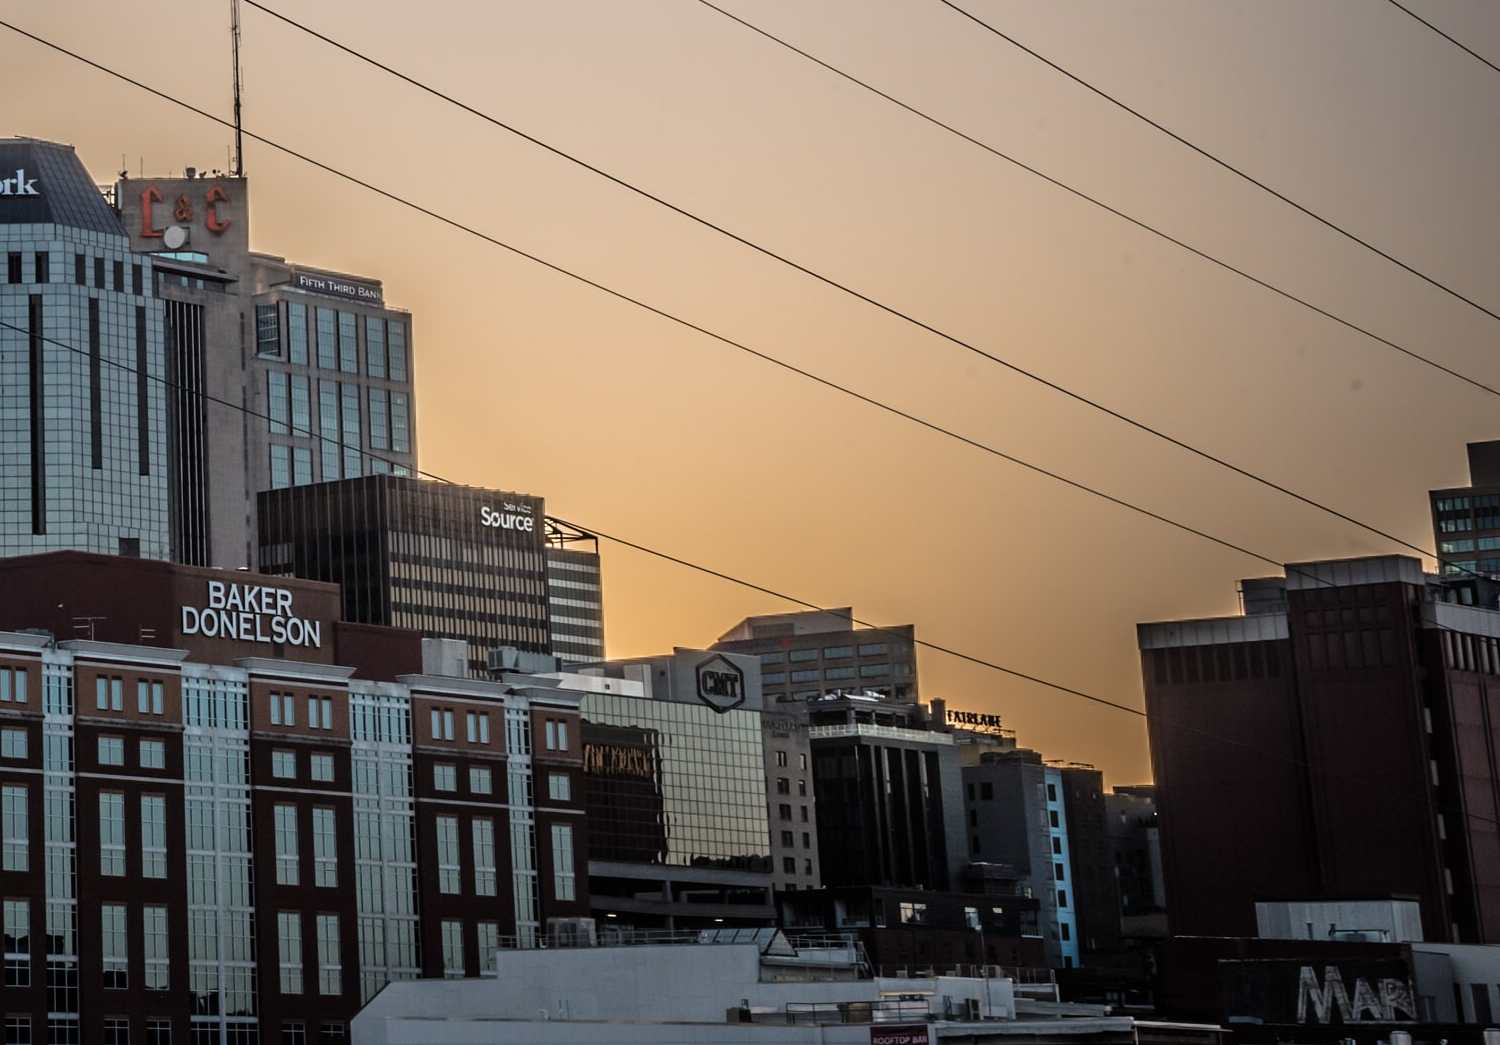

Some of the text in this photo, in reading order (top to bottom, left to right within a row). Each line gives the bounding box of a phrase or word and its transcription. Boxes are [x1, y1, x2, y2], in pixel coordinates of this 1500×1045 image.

[173, 193, 195, 222] &
[300, 276, 325, 289] FIFTH
[327, 281, 356, 295] THIRD
[481, 506, 533, 532] Source
[208, 580, 293, 617] BAKER
[182, 605, 321, 648] DONELSON
[702, 668, 738, 698] CMT
[947, 709, 1002, 728] FAIRLANE
[873, 1035, 928, 1045] ROOFTOP BAR
